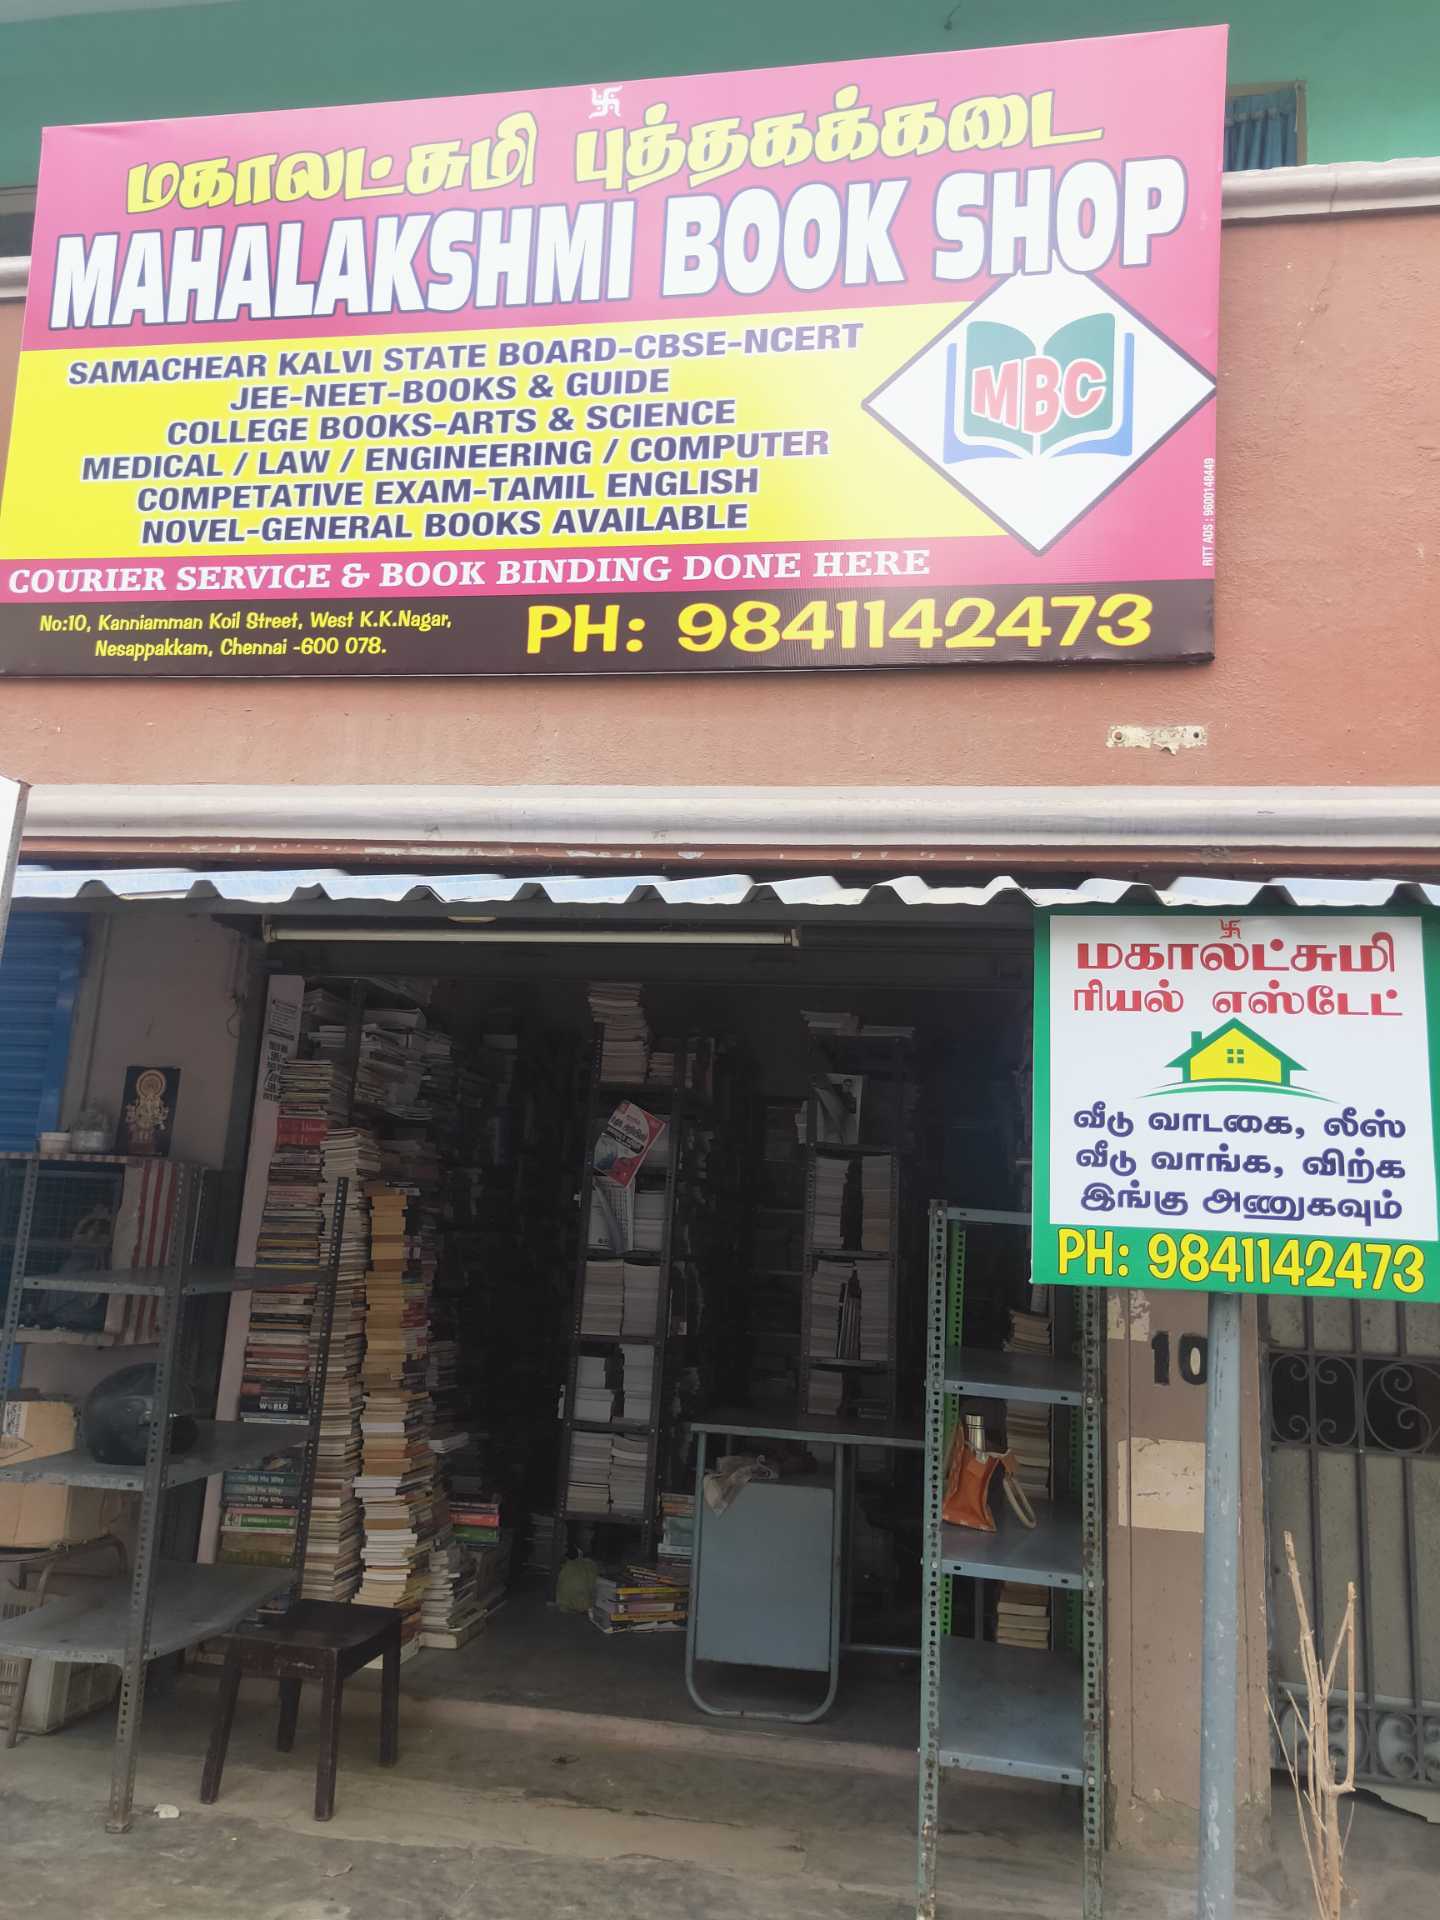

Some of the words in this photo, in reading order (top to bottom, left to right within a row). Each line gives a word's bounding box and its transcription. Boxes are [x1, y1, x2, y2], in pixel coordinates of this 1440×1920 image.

[127, 112, 538, 213] மகாலட்சுமி
[574, 85, 1104, 193] புத்தகக்கடை
[49, 199, 638, 330] MAHALAKSHMI
[661, 178, 909, 299] BOOK
[933, 156, 1188, 281] SHOP
[69, 354, 267, 384] SAMACHEAR
[278, 350, 372, 377] KALVI
[383, 344, 486, 373] STATE
[499, 323, 864, 367] BOARD-CBSE-NCERT
[230, 375, 516, 411] JEE-NEET-BOOKS
[528, 374, 554, 398] &
[566, 368, 670, 396] GUIDE
[971, 355, 1106, 435] MBC
[167, 417, 308, 445] COLLEGE
[319, 409, 537, 440] BOOKS-ARTS
[548, 406, 574, 430] &
[586, 400, 736, 430] SCIENCE
[81, 454, 223, 480] MEDICAL
[233, 452, 249, 475] /
[258, 450, 329, 475] LAW
[340, 448, 355, 473] /
[365, 440, 592, 472] ENGINEERING
[603, 439, 619, 463] /
[630, 430, 829, 463] COMPUTER
[138, 482, 363, 512] COMPETATIVE
[375, 473, 595, 504] EXAM-TAMIL
[607, 468, 759, 498] ENGLISH
[142, 514, 413, 544] NOVEL-GENERAL
[424, 510, 541, 538] BOOKS
[552, 504, 749, 534] AVAILABLE
[1202, 524, 1214, 544] ADS
[8, 568, 166, 594] COURIER
[176, 564, 331, 591] SERVICE
[341, 563, 370, 589] &
[379, 560, 486, 588] BOOK
[496, 556, 672, 585] BINDING
[682, 553, 801, 580] DONE
[812, 549, 931, 577] HERE
[39, 615, 92, 633] No:10,
[98, 613, 202, 631] Kanniamman
[209, 611, 241, 630] Koil
[246, 611, 303, 631] Street,
[310, 610, 354, 629] West
[360, 609, 452, 634] K.K.Nagar,
[526, 603, 646, 655] PH:
[678, 593, 1153, 654] 9841142473
[95, 638, 213, 661] Nesappakkam,
[220, 638, 287, 656] Chennai
[345, 637, 387, 655] 078.
[1076, 931, 1396, 974] மகாலட்சுமி
[1073, 978, 1185, 1014] ரியல்
[1212, 979, 1403, 1016] எஸ்டேட்
[1073, 1101, 1134, 1138] வீடு
[1147, 1110, 1306, 1140] வாடகை,
[1323, 1106, 1407, 1139] லீஸ்
[1075, 1139, 1137, 1176] வீடு
[1150, 1142, 1284, 1177] வாங்க,
[1302, 1147, 1406, 1184] விற்க
[1080, 1179, 1188, 1216] இங்கு
[1202, 1188, 1403, 1227] அணுகவும்
[1057, 1228, 1130, 1277] PH:
[1147, 1232, 1426, 1294] 9841142473
[1151, 1330, 1208, 1386] 10
